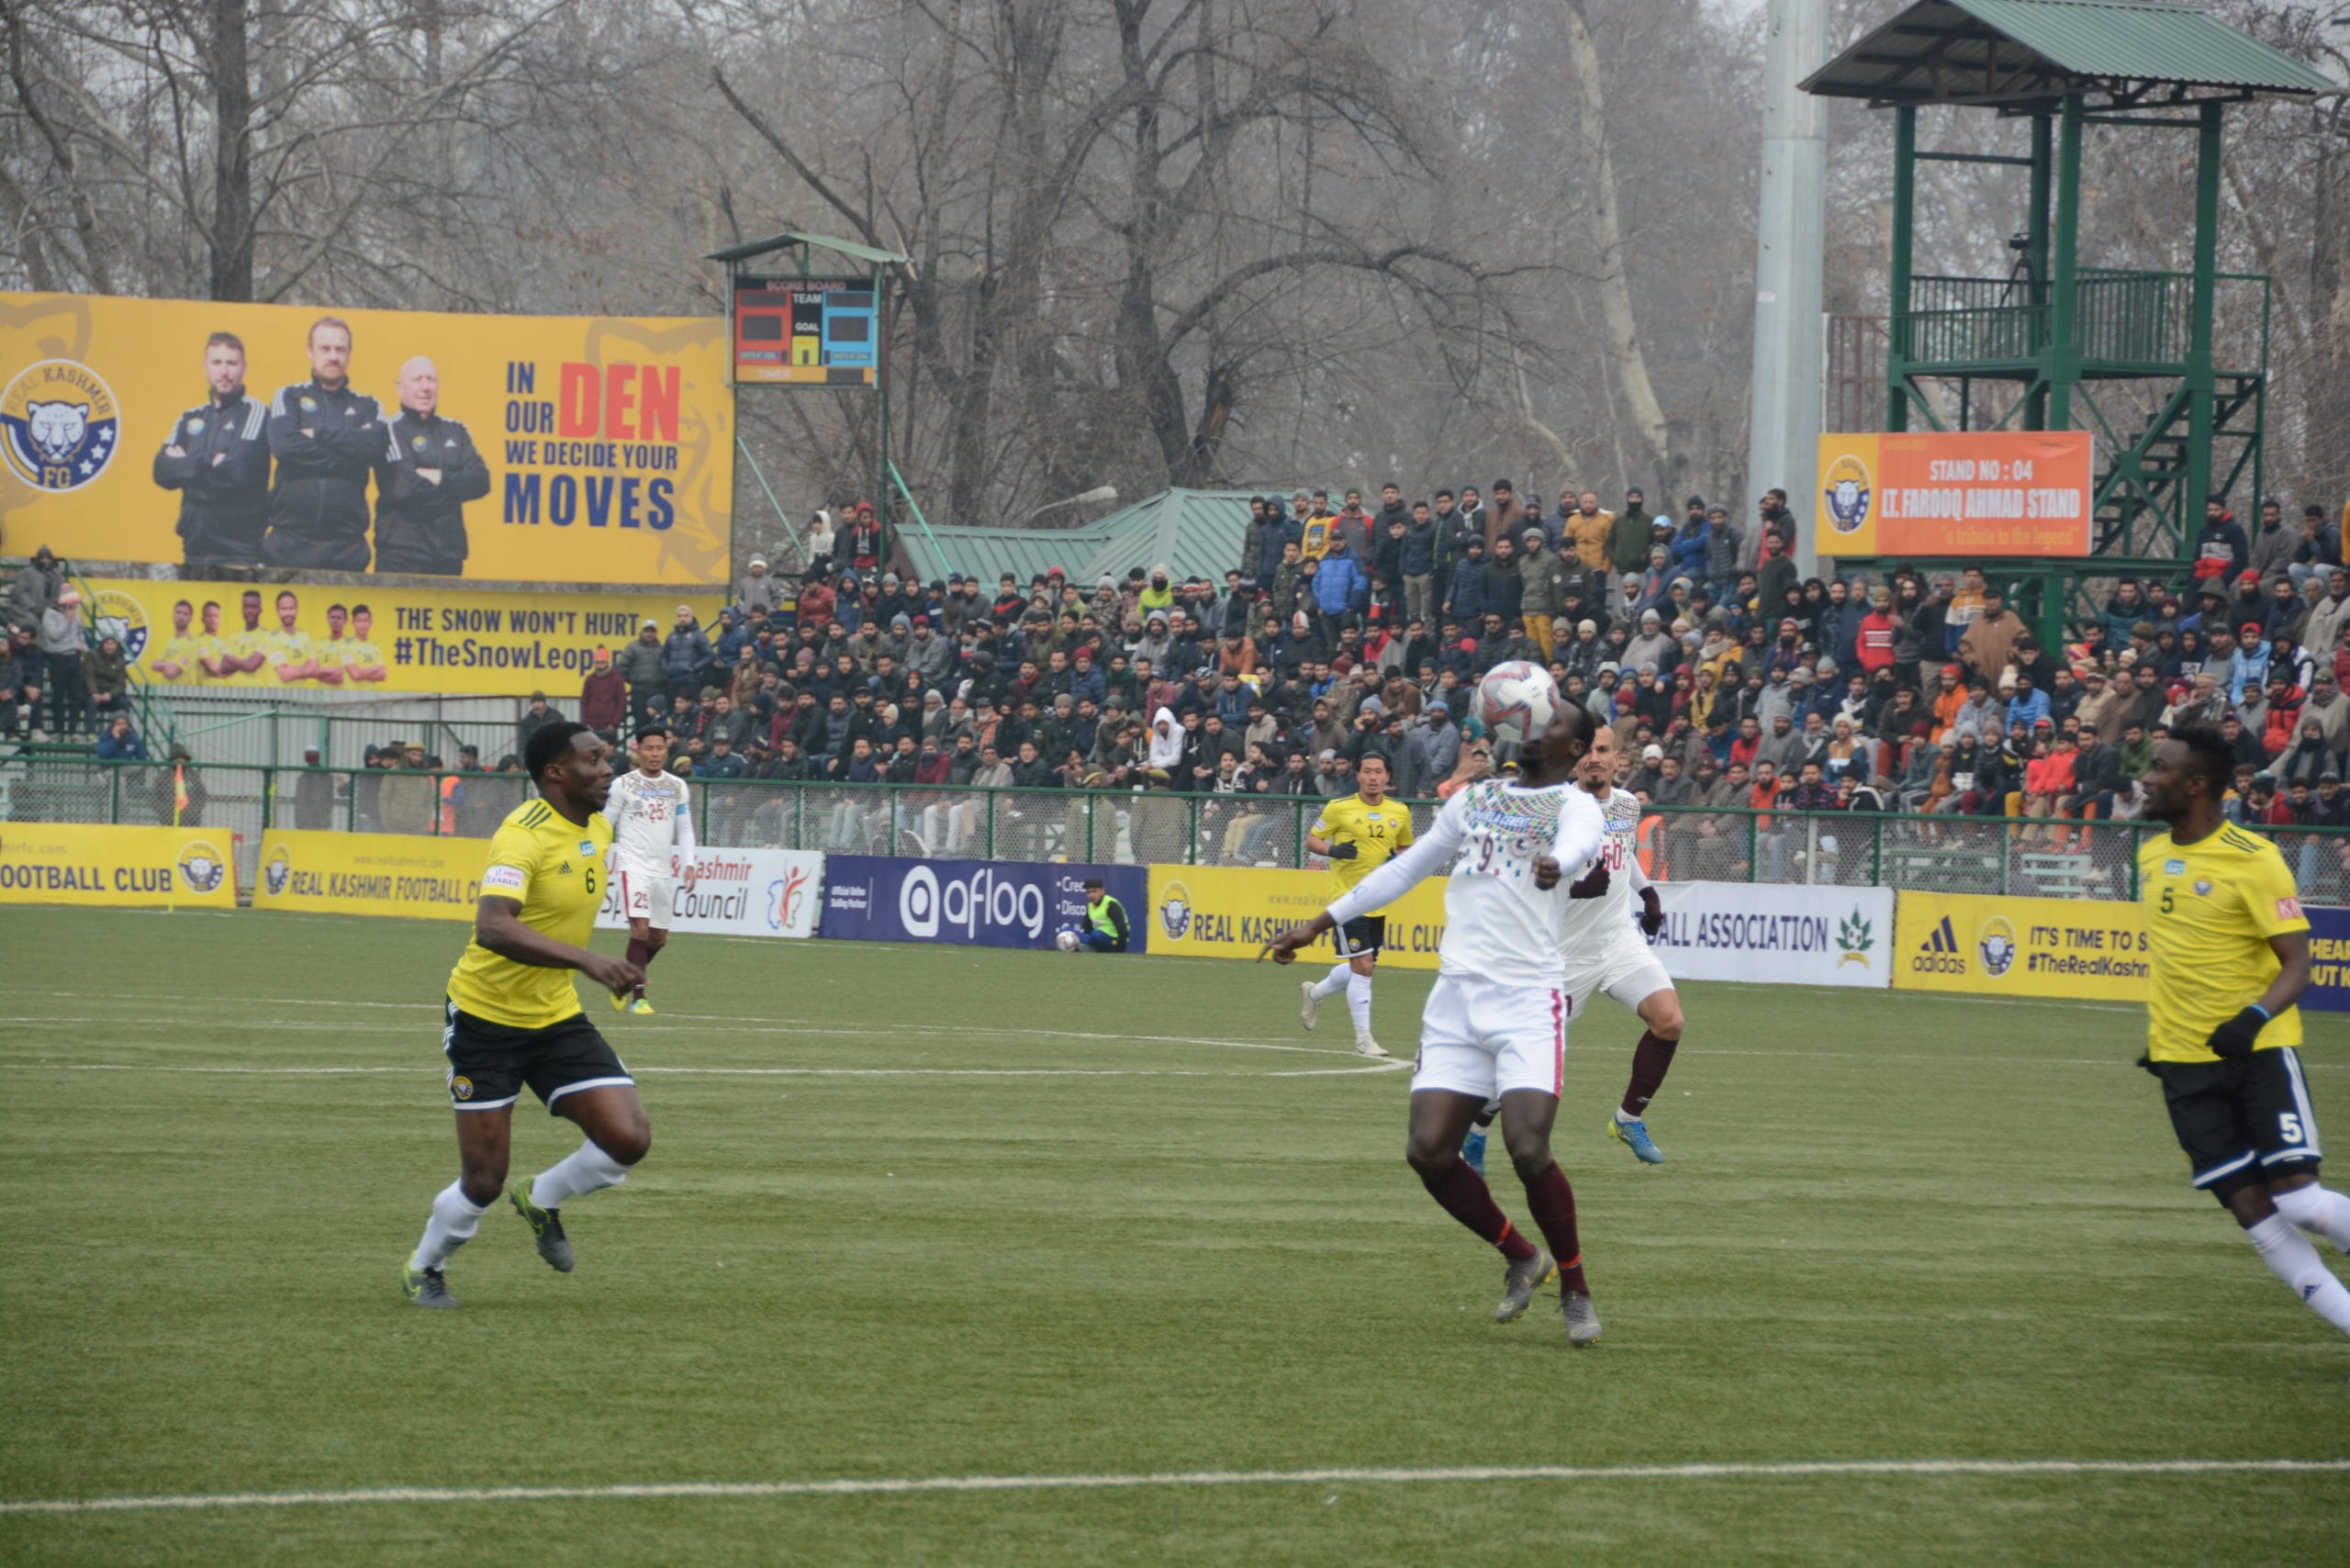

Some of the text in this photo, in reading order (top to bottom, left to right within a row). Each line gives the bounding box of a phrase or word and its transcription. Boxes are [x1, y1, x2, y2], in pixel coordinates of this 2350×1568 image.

[792, 294, 822, 304] TEAM
[795, 322, 820, 331] GOAL
[43, 366, 110, 416] KASHMIR
[507, 362, 534, 394] IN
[506, 362, 681, 442] OUR DEN
[505, 440, 677, 470] WE DECIDE YOUR
[43, 466, 71, 488] FC
[1930, 460, 1975, 481] STAND
[1979, 460, 1999, 480] NO
[2012, 460, 2033, 481] 04
[503, 473, 675, 531] MOVES
[1902, 488, 1963, 521] FAROOQ
[1965, 488, 2024, 518] AHMAD
[2028, 488, 2081, 519] STAND
[1957, 527, 1995, 545] tribute
[1998, 529, 2009, 545] to
[396, 607, 640, 636] THE SNOW WON'T HURT
[395, 636, 621, 677] #TheSnowLeopr
[648, 802, 665, 821] 25
[1368, 824, 1384, 838] 12
[0, 864, 172, 891] OOTBALL CLUB
[586, 867, 596, 894] 6
[670, 854, 753, 881] & ashmir
[290, 870, 323, 896] REAL
[329, 873, 392, 900] KASHMIR
[396, 876, 462, 903] FOOTBALL
[2160, 887, 2175, 914] 5
[672, 887, 748, 921] Council
[943, 868, 1045, 939] aflog
[1061, 900, 1087, 916] Disco
[1193, 913, 1235, 942] REAL
[1412, 924, 1446, 952] CLU
[1696, 913, 1828, 952] ASSOCIATION
[2030, 926, 2059, 946] IT'S
[2065, 928, 2104, 949] TIME
[2109, 931, 2132, 951] TO
[1913, 951, 1965, 974] adidas
[2279, 1112, 2303, 1144] 5
